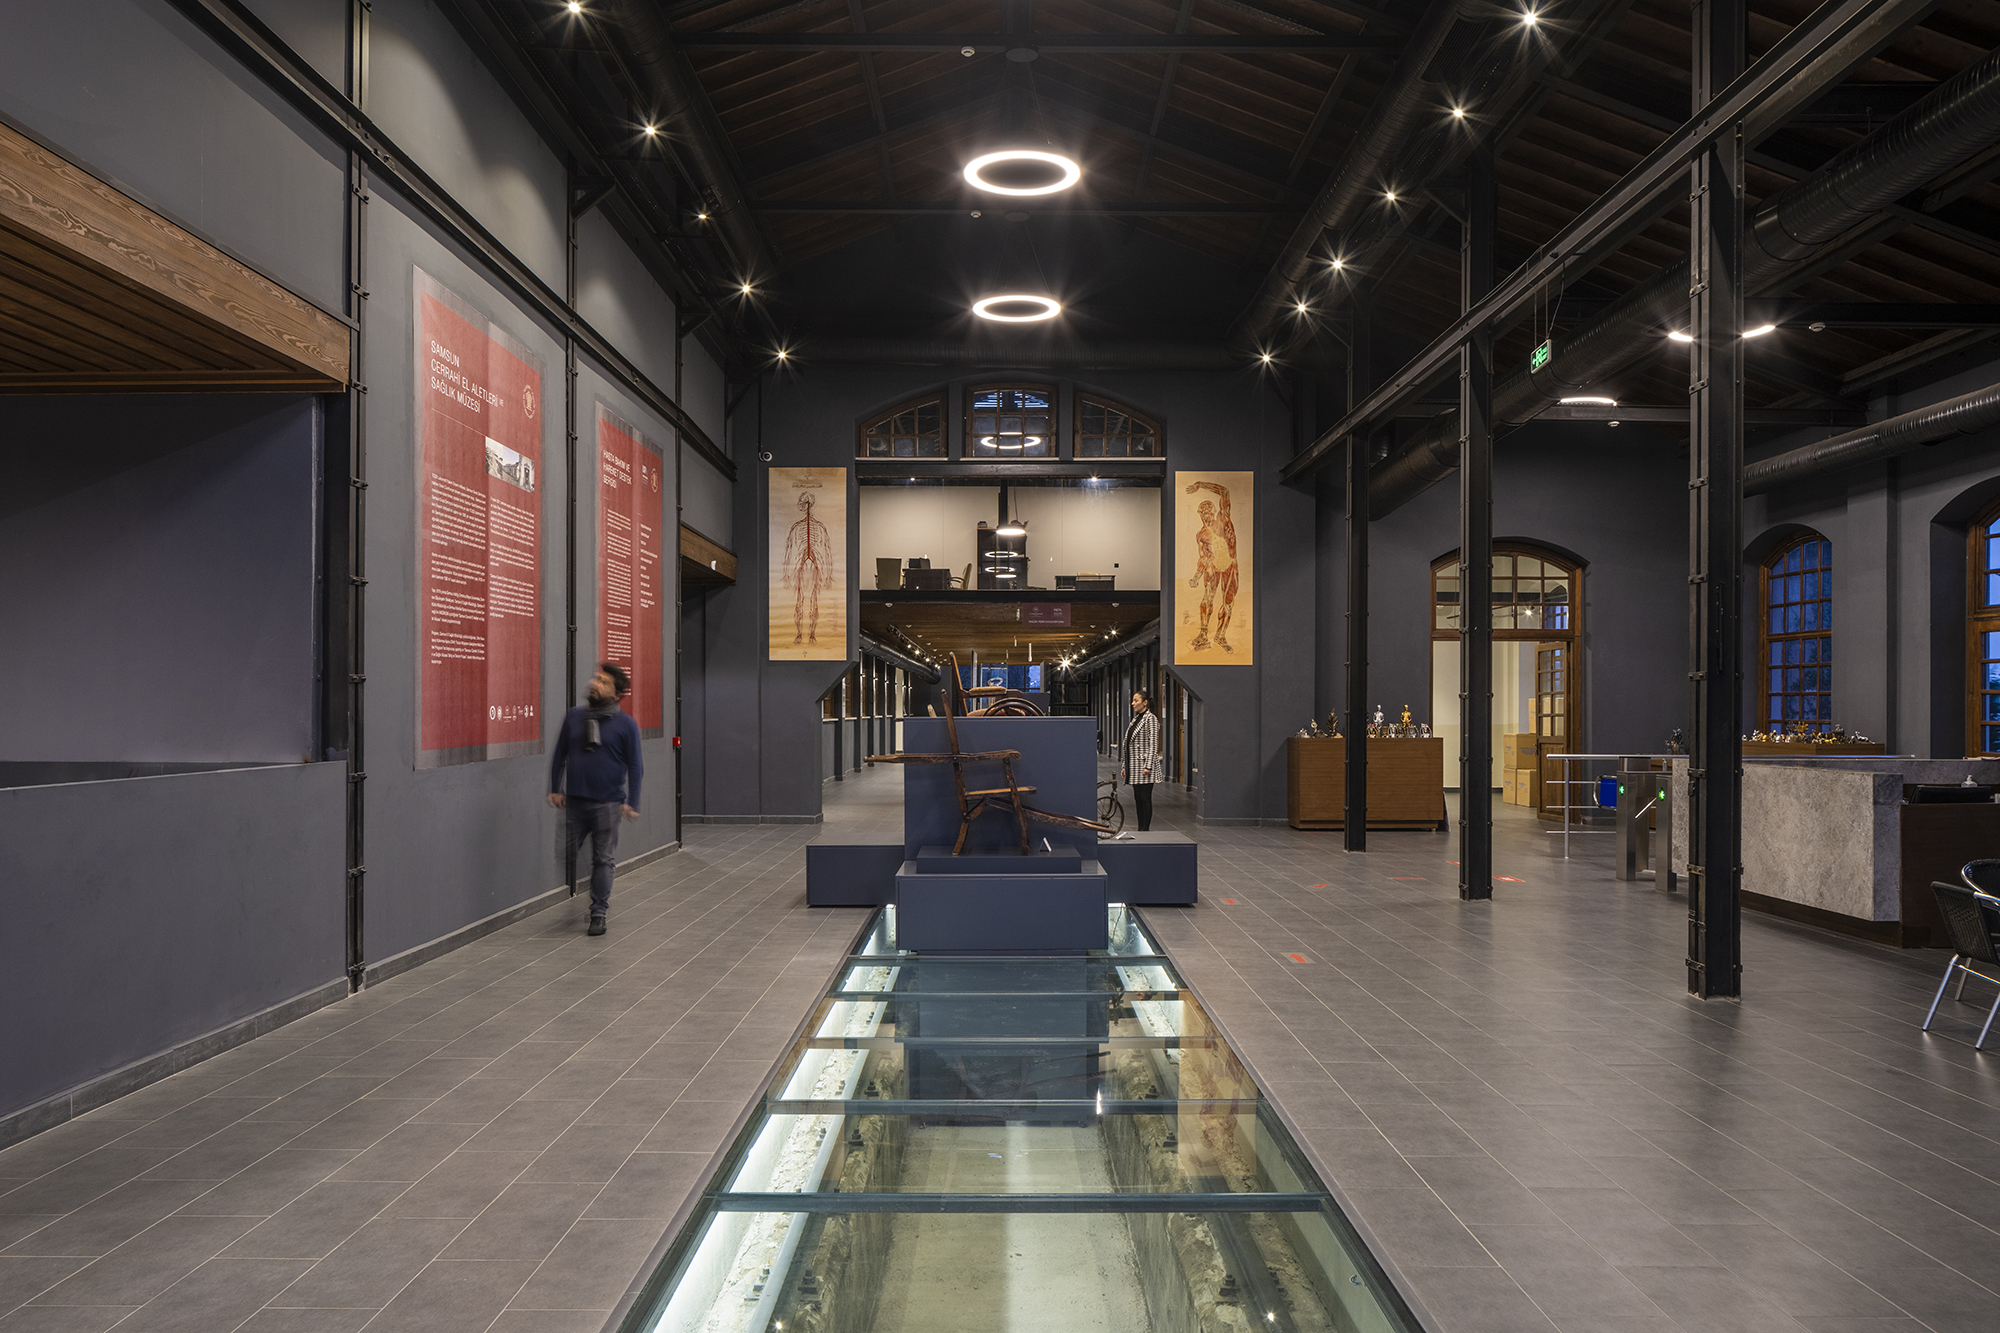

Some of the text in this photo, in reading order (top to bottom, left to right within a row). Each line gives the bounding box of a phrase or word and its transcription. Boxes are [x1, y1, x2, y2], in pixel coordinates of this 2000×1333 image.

[431, 340, 460, 368] SAMSUN
[431, 358, 461, 386] CERRAHİ
[462, 376, 470, 391] EL
[471, 382, 498, 408] ALETLERİ
[431, 376, 481, 414] SAĞLIK MÜZESİ
